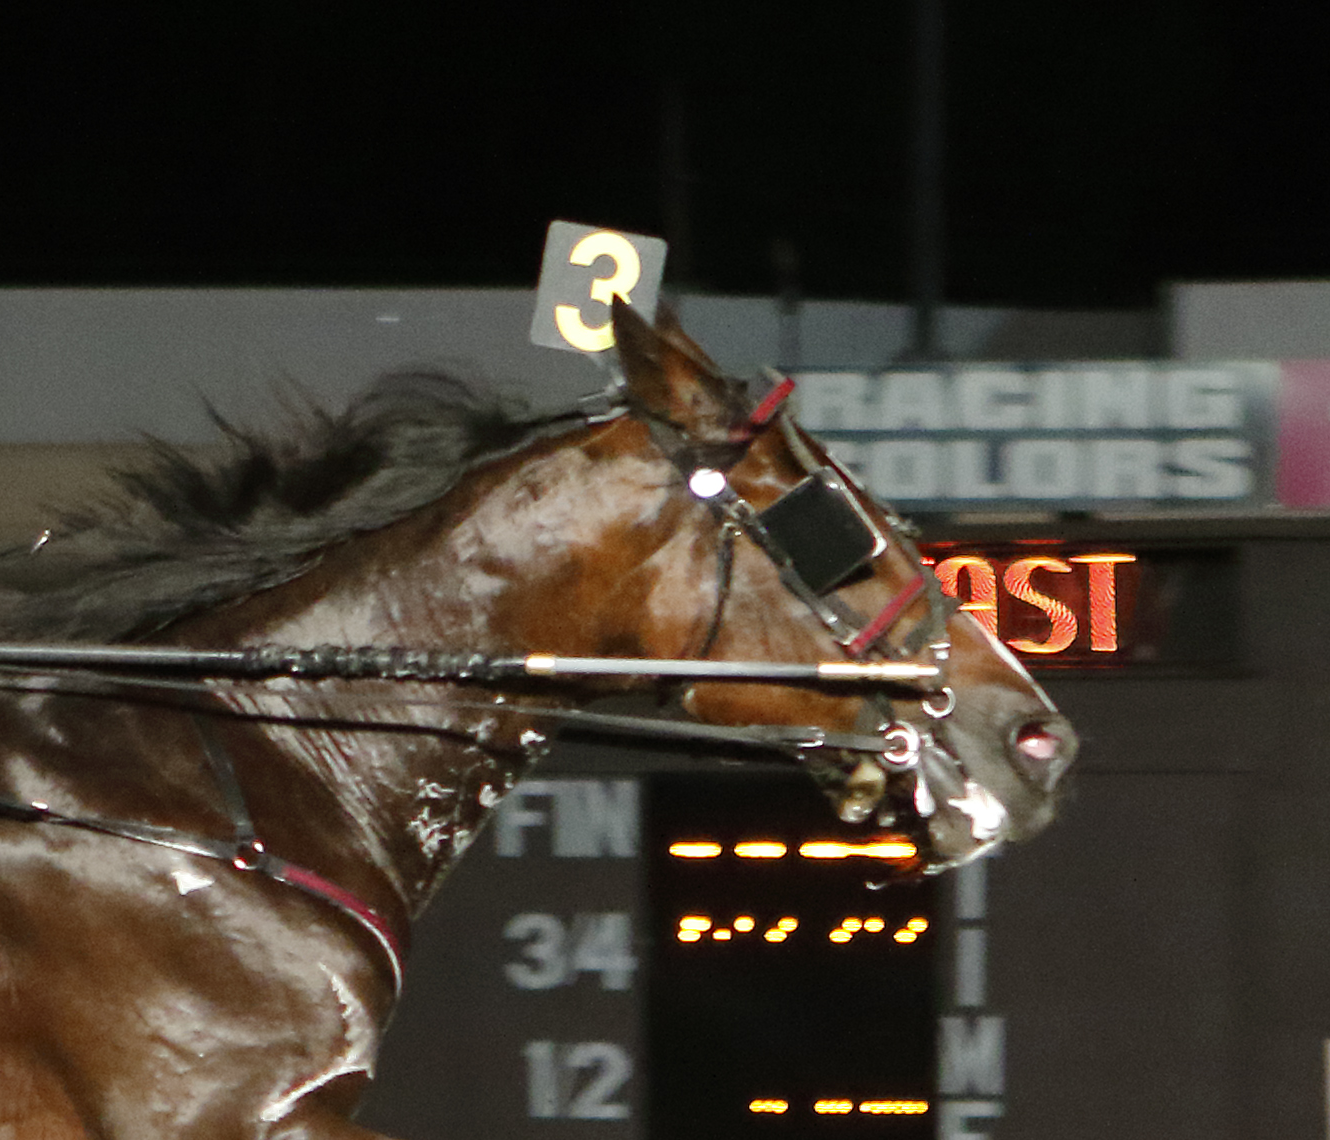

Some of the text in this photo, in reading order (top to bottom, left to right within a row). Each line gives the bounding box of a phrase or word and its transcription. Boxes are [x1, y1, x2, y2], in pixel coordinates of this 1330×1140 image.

[555, 230, 640, 351] 3
[796, 370, 1245, 431] RACING
[933, 554, 1137, 654] AST
[494, 778, 639, 858] FIN
[501, 912, 637, 992] 34
[522, 1040, 633, 1119] 12
